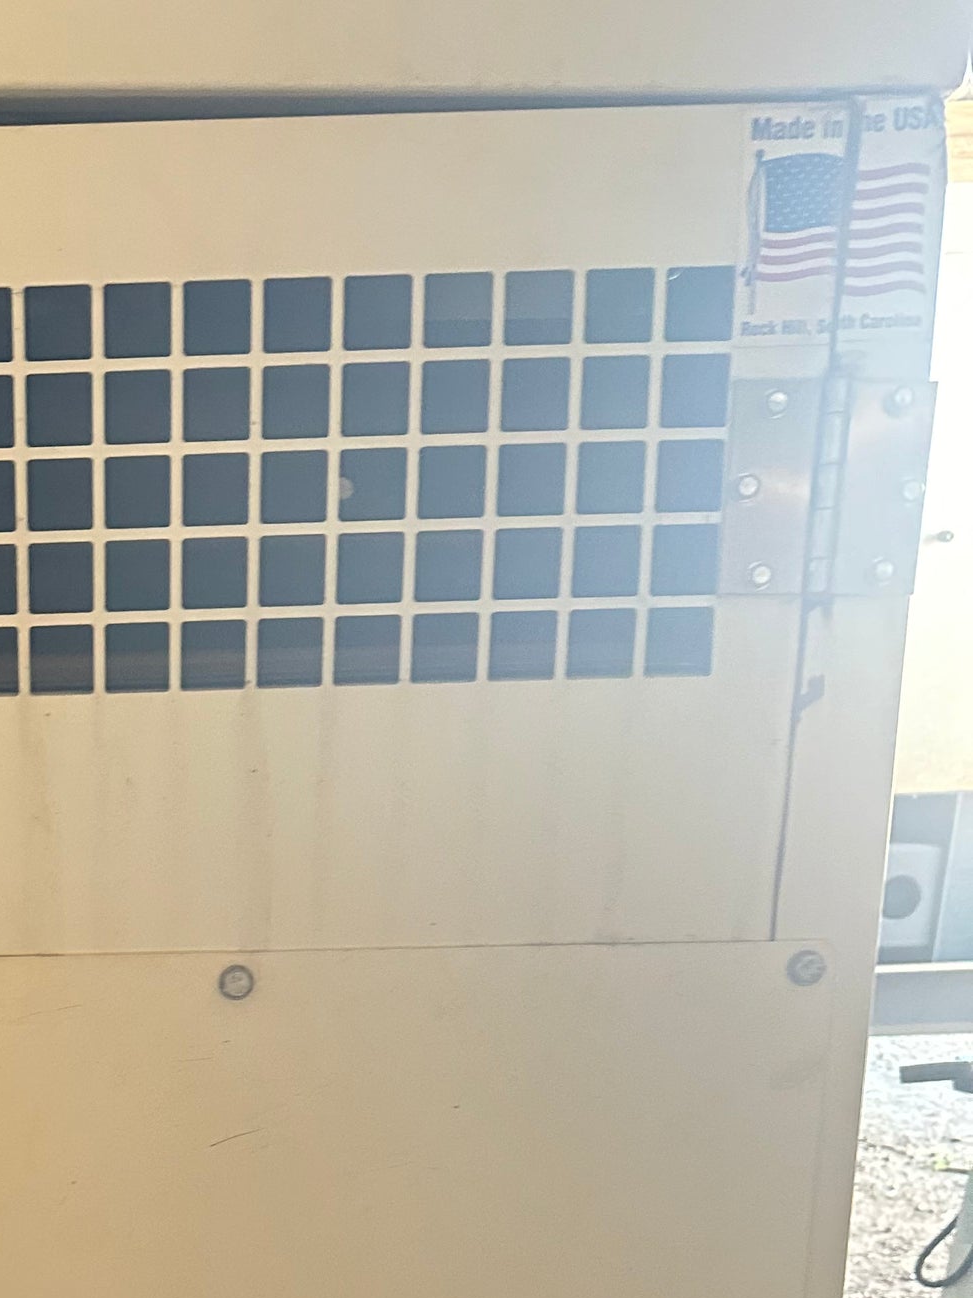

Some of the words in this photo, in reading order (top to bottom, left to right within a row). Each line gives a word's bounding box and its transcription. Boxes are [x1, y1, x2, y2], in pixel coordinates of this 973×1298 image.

[753, 116, 815, 140] Made
[823, 114, 843, 138] in
[894, 106, 942, 131] USA
